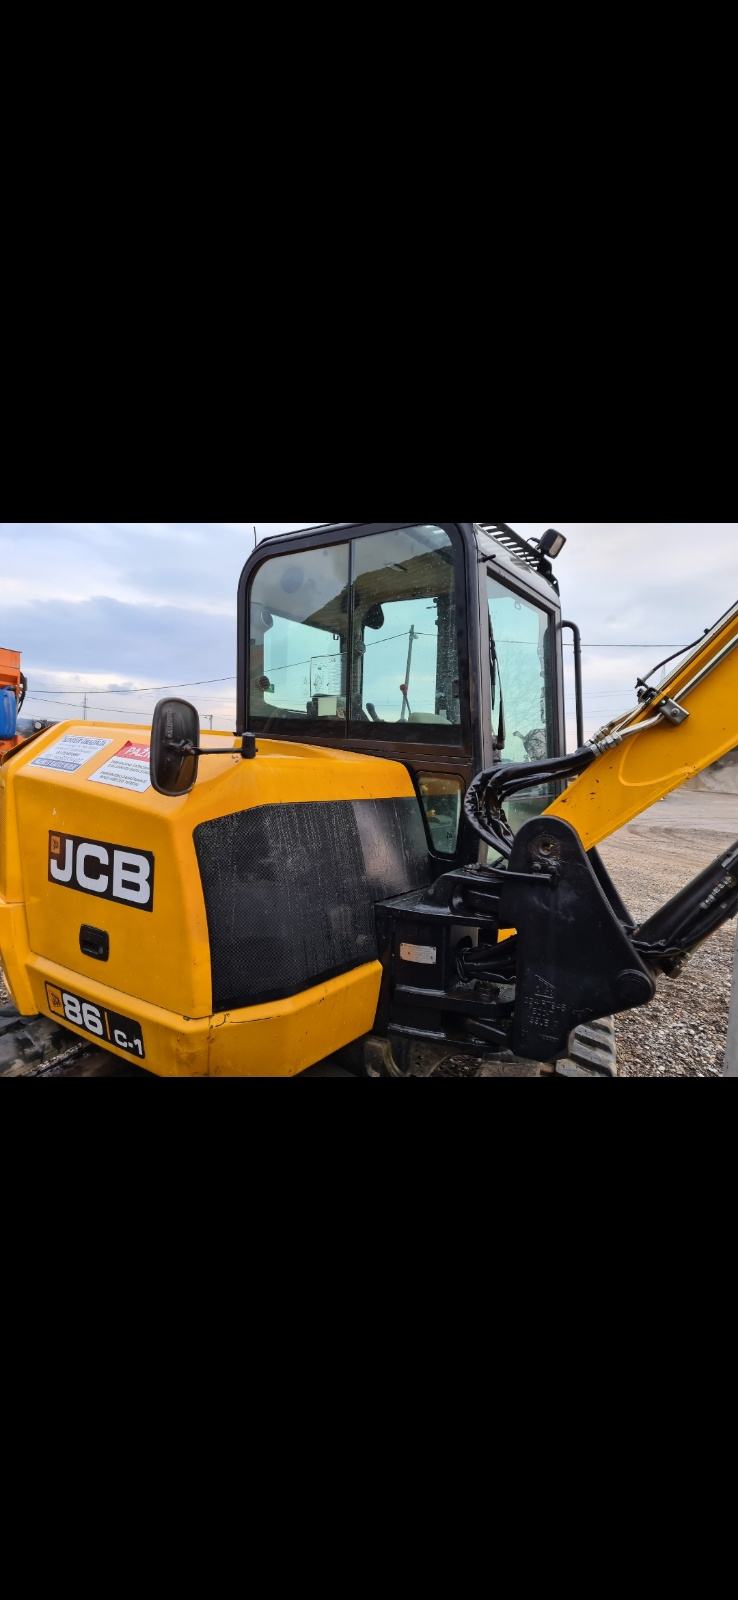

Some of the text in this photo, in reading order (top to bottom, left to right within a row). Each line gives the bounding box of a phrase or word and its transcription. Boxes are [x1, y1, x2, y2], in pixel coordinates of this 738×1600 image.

[50, 838, 150, 904] JCB
[62, 992, 143, 1056] 86 C-1
